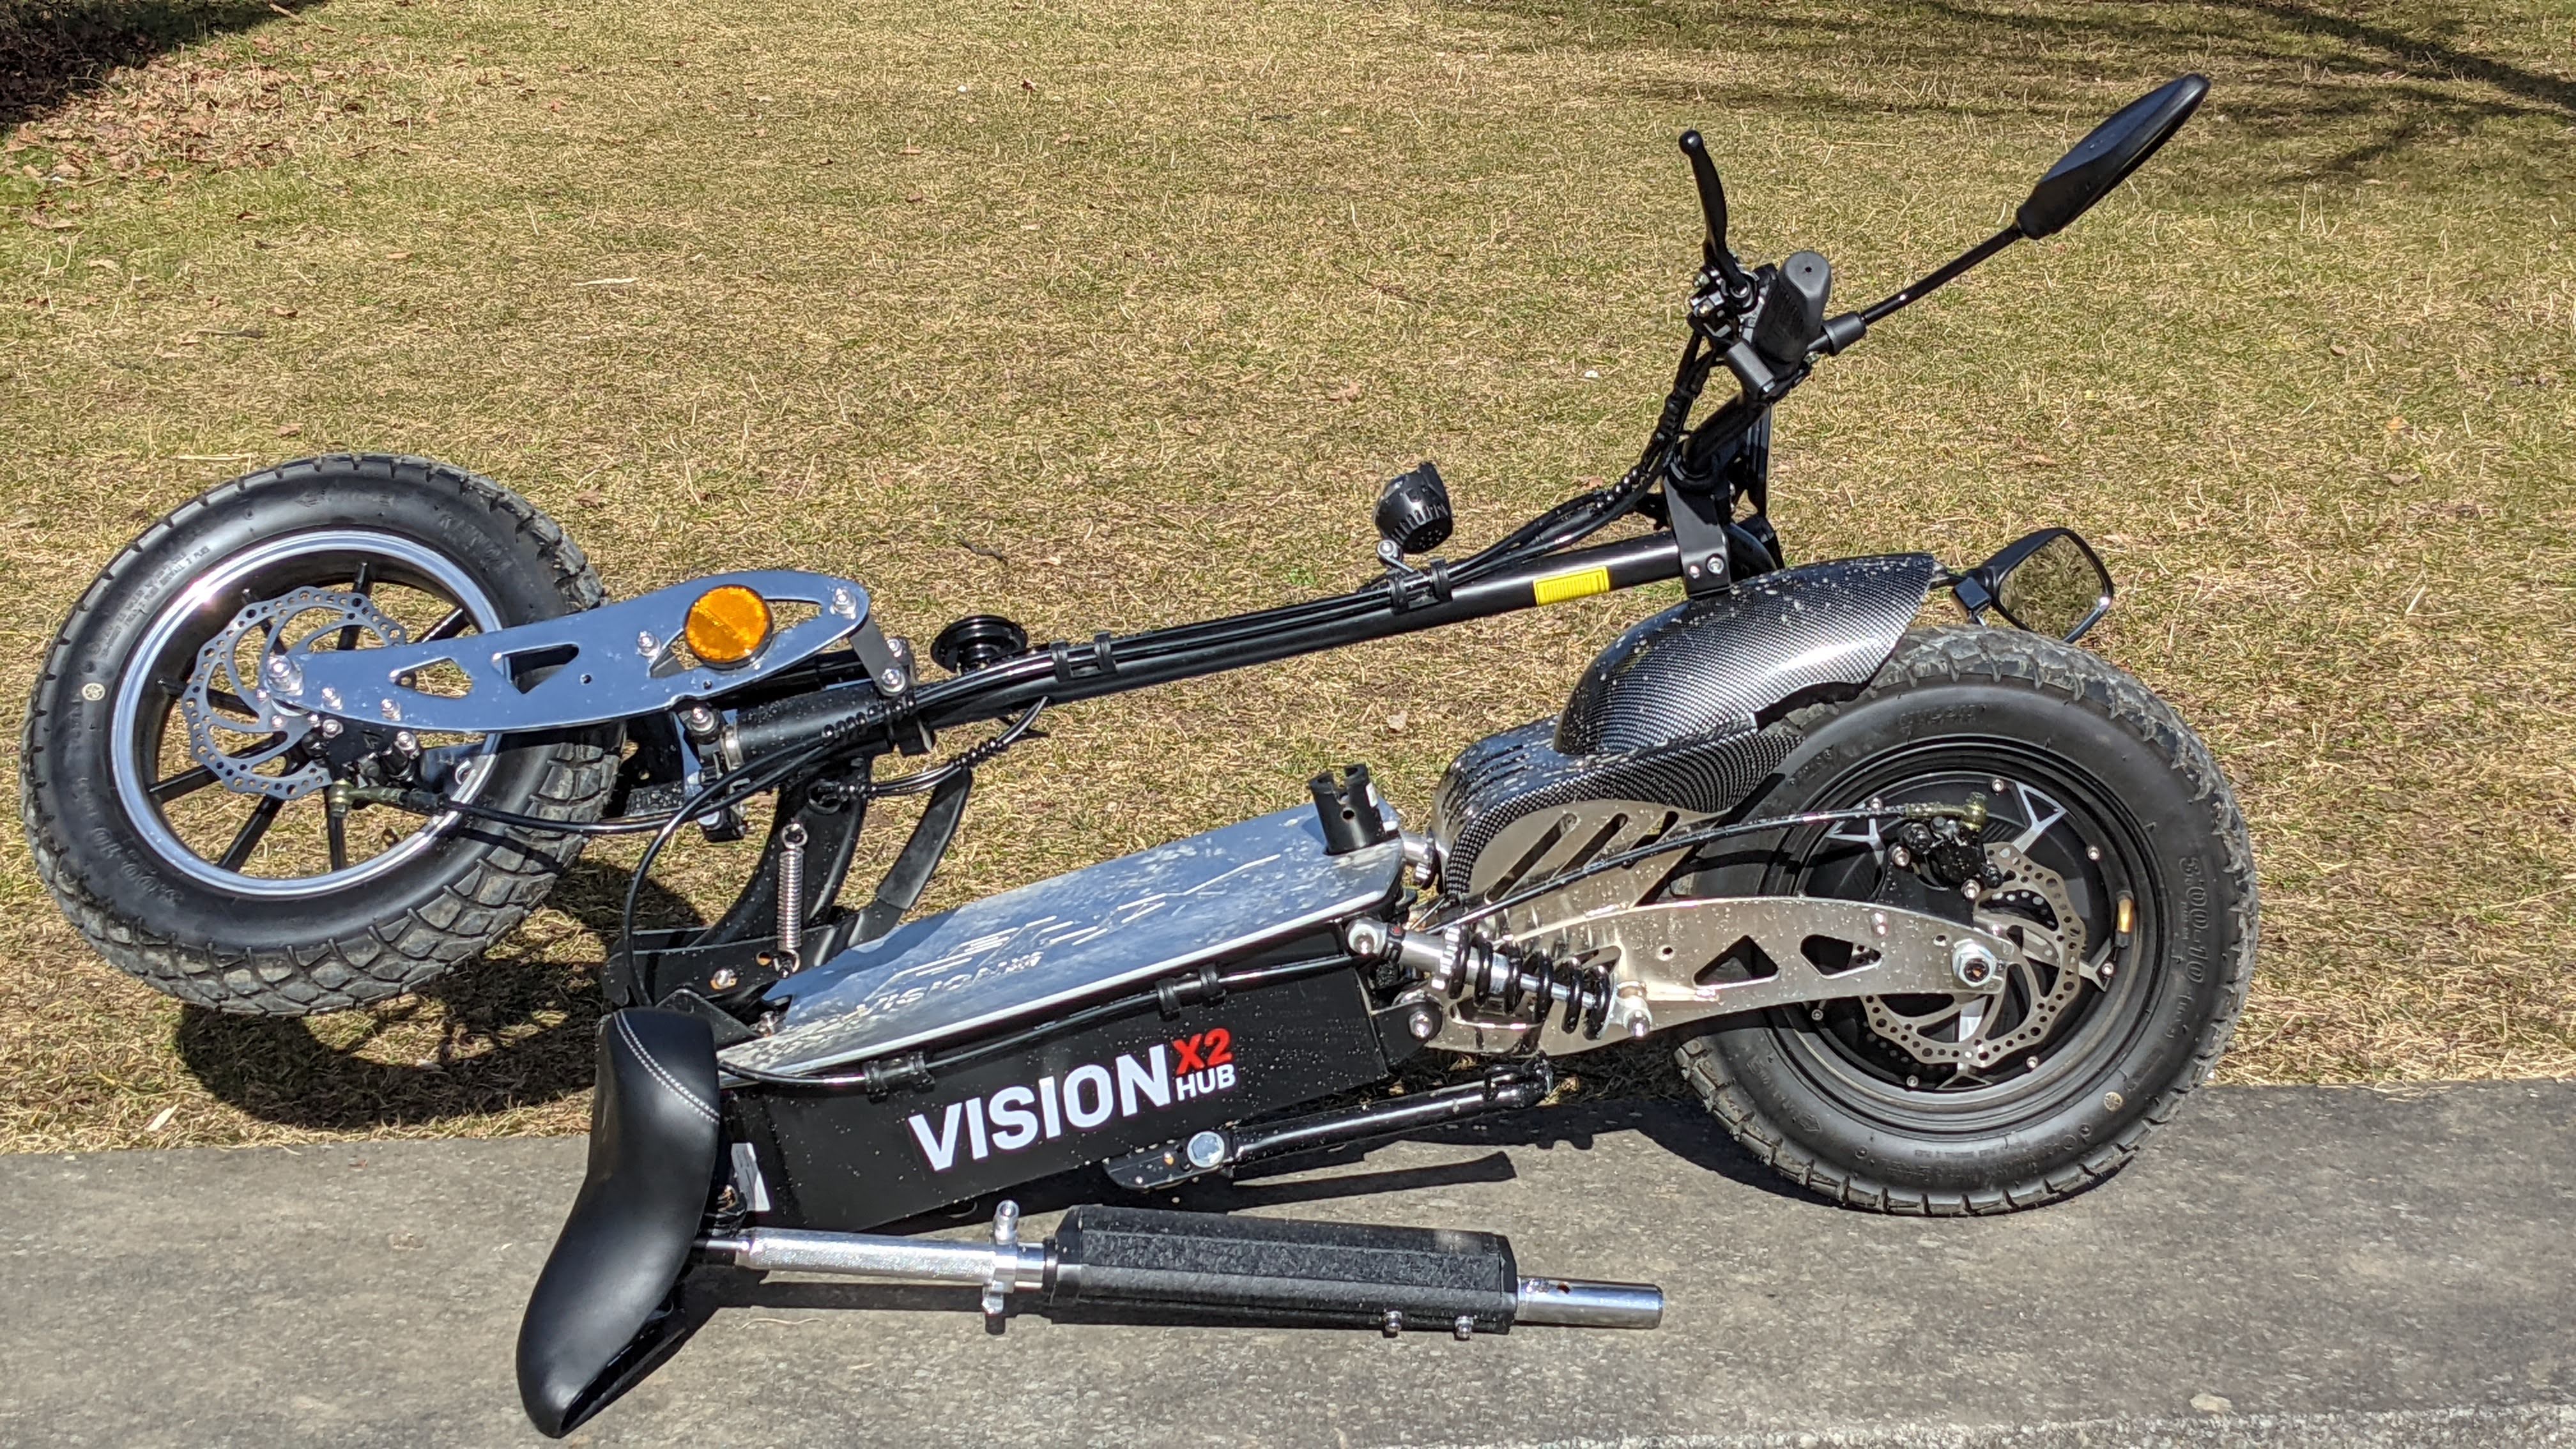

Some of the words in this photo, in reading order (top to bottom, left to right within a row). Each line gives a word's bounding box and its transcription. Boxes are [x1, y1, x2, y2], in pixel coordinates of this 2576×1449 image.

[908, 1044, 1171, 1172] VISION
[1172, 1028, 1233, 1075] X2
[1175, 1064, 1236, 1101] HUB
